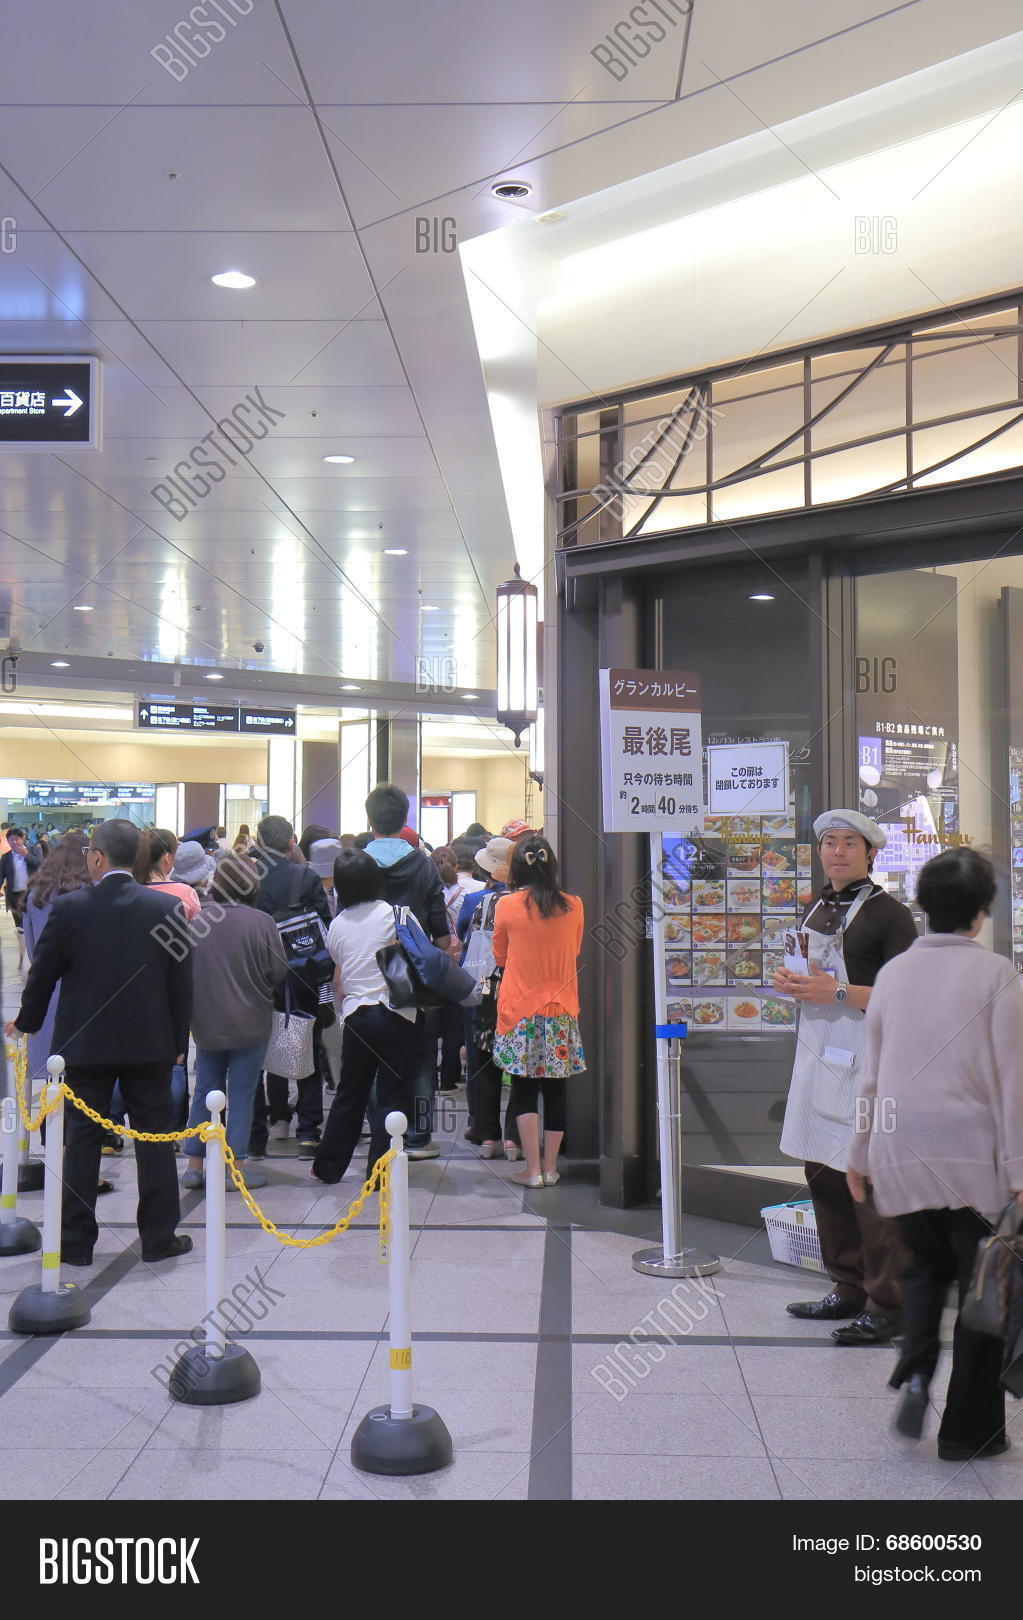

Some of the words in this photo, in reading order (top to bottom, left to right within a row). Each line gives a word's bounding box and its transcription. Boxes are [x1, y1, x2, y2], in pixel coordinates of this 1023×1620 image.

[0, 391, 46, 407] 百貨店
[614, 680, 697, 698] グランカルビー
[622, 726, 692, 756] 最後尾
[862, 745, 878, 765] B1
[623, 772, 693, 786] 只今の待ち時間
[731, 766, 763, 777] この扉は
[715, 778, 779, 790] 閉鎖しております
[631, 796, 640, 815] 2
[657, 795, 676, 815] 40
[678, 804, 699, 814] 分待ち
[899, 815, 971, 850] Hankyu
[676, 844, 706, 861] 12F
